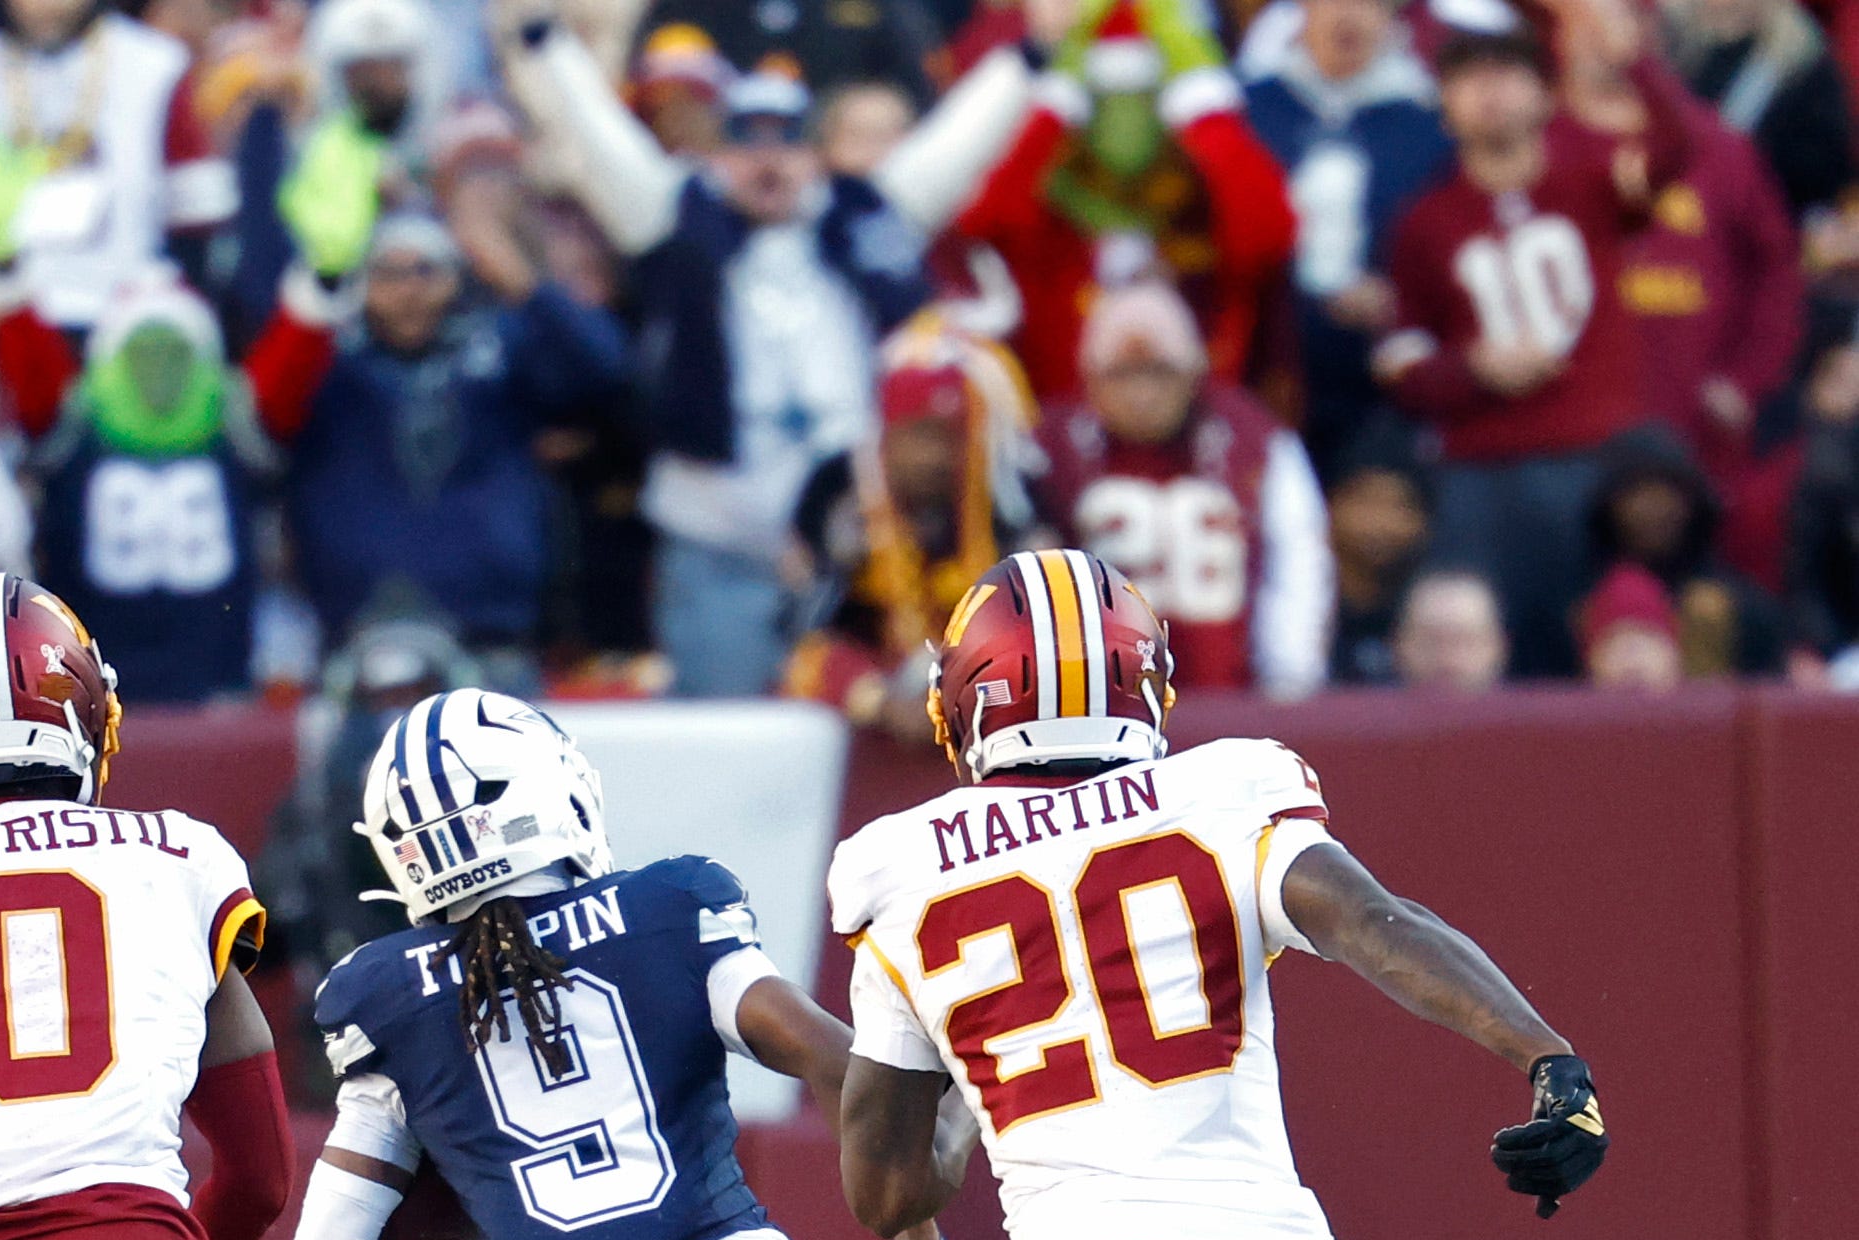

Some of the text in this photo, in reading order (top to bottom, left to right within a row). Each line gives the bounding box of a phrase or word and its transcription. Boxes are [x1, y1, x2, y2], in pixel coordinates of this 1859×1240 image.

[1455, 215, 1593, 356] 10
[1075, 474, 1247, 624] 26
[424, 857, 513, 904] COWBOYS
[928, 767, 1160, 874] MARTIN
[404, 885, 627, 997] TPIN
[912, 828, 1247, 1139] 20
[469, 966, 678, 1232] 9
